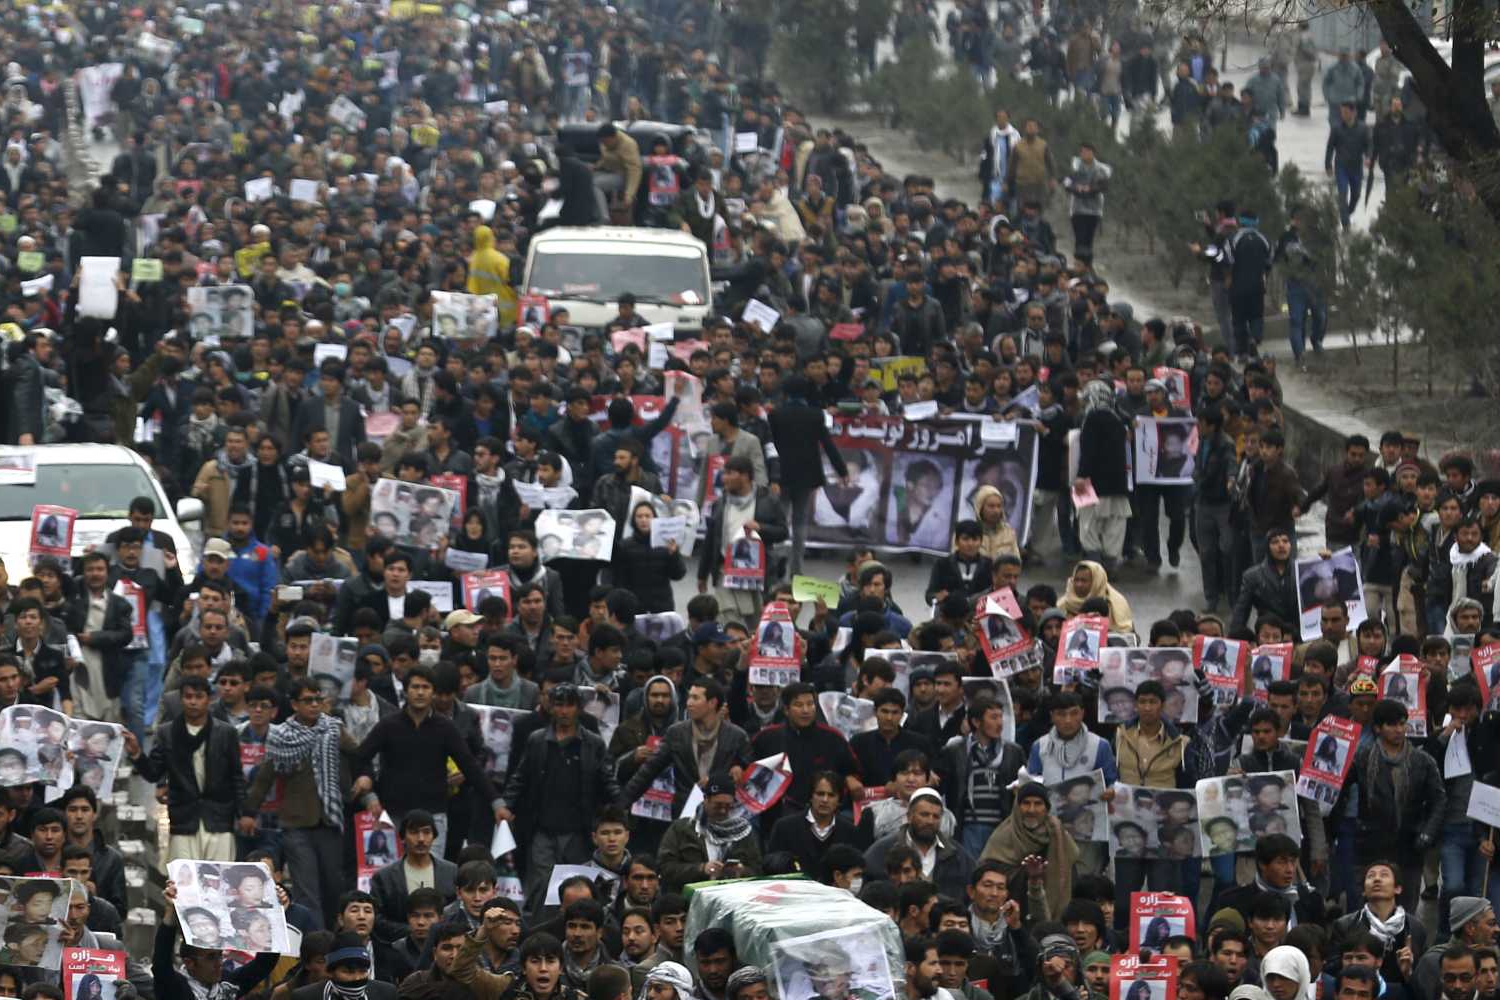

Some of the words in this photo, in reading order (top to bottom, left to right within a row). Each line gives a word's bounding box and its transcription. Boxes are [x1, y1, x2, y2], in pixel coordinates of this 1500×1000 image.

[847, 421, 904, 447] نوبت
[908, 423, 973, 451] امروز
[1140, 894, 1183, 905] هزاره
[72, 950, 115, 962] هزاره
[1120, 957, 1167, 969] هزاره
